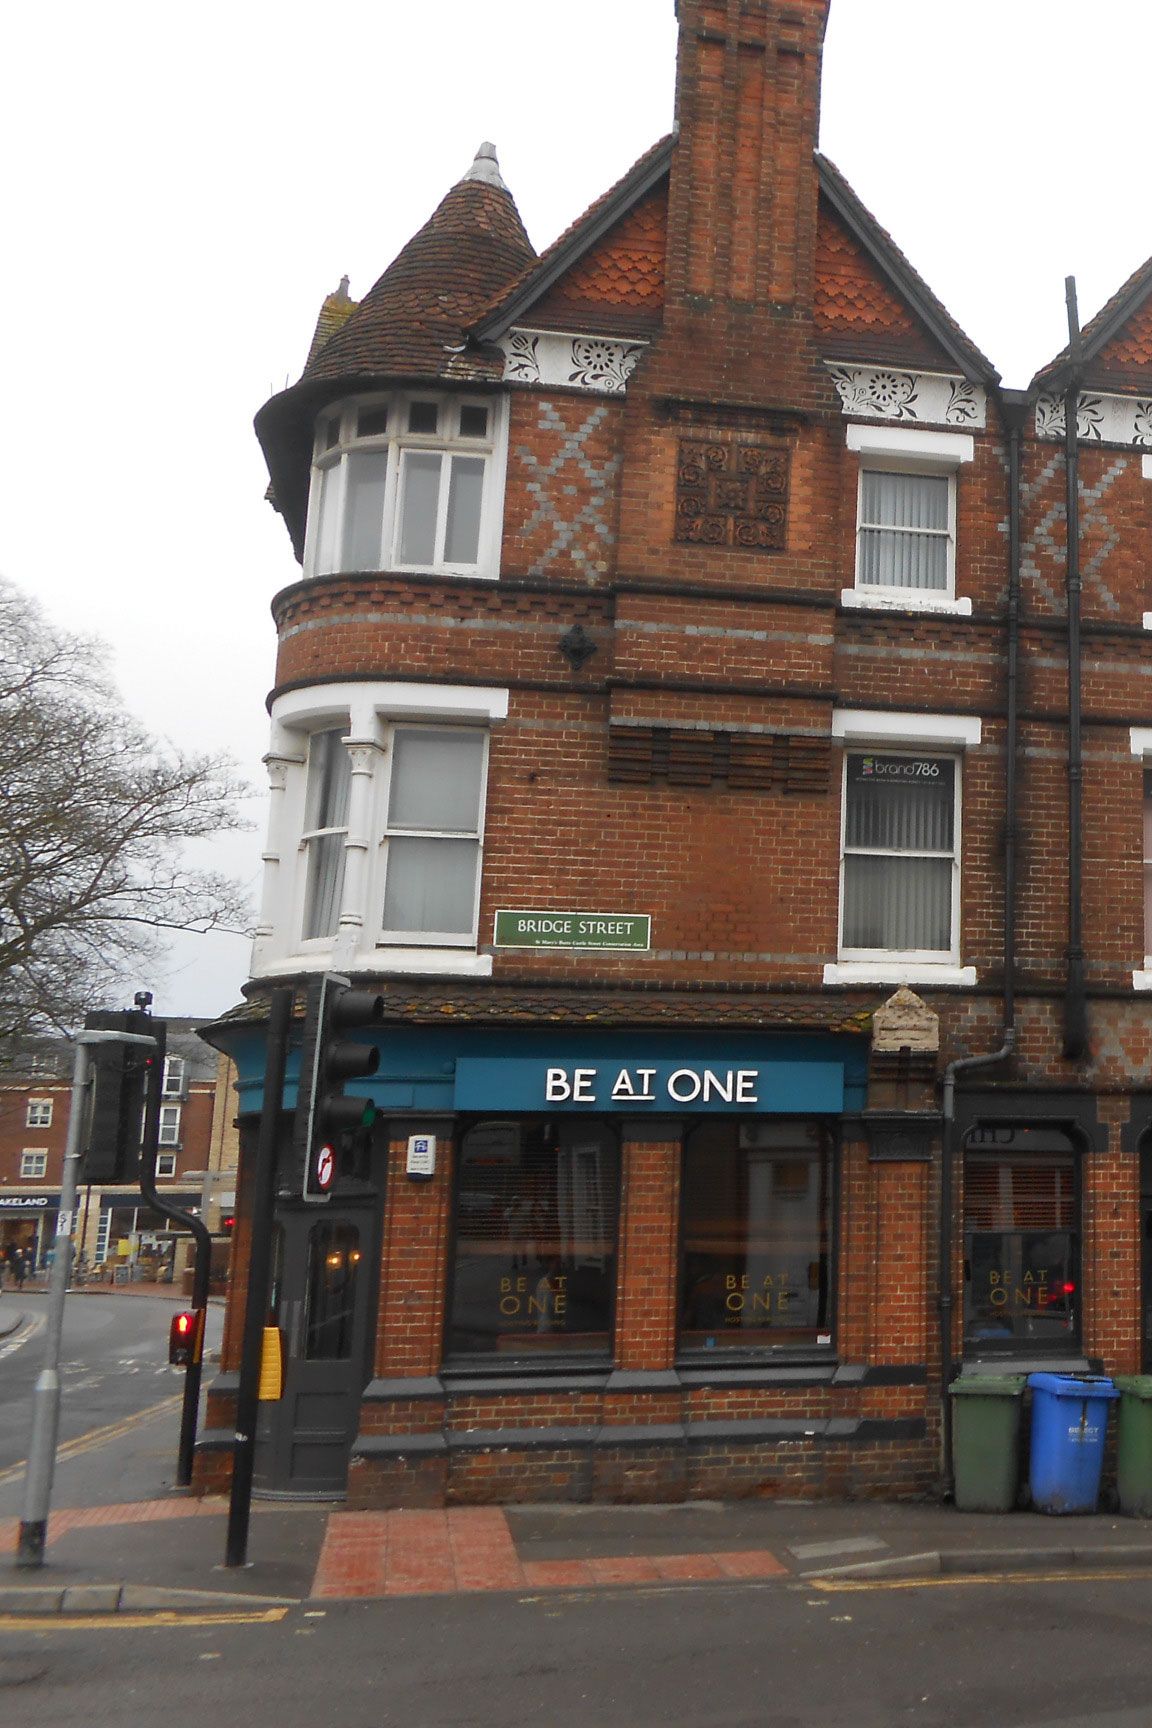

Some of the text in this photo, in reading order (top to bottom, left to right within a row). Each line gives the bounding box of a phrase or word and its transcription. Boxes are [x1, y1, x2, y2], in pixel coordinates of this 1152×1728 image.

[875, 760, 939, 776] brand786
[518, 919, 634, 935] BRIDGE STREET
[546, 1068, 758, 1102] BE AT ONE
[501, 1276, 567, 1293] BE AT
[726, 1274, 788, 1289] BE AT
[990, 1270, 1048, 1285] BE AT
[500, 1295, 567, 1315] ONE
[726, 1292, 789, 1312] ONE
[990, 1287, 1048, 1306] ONE
